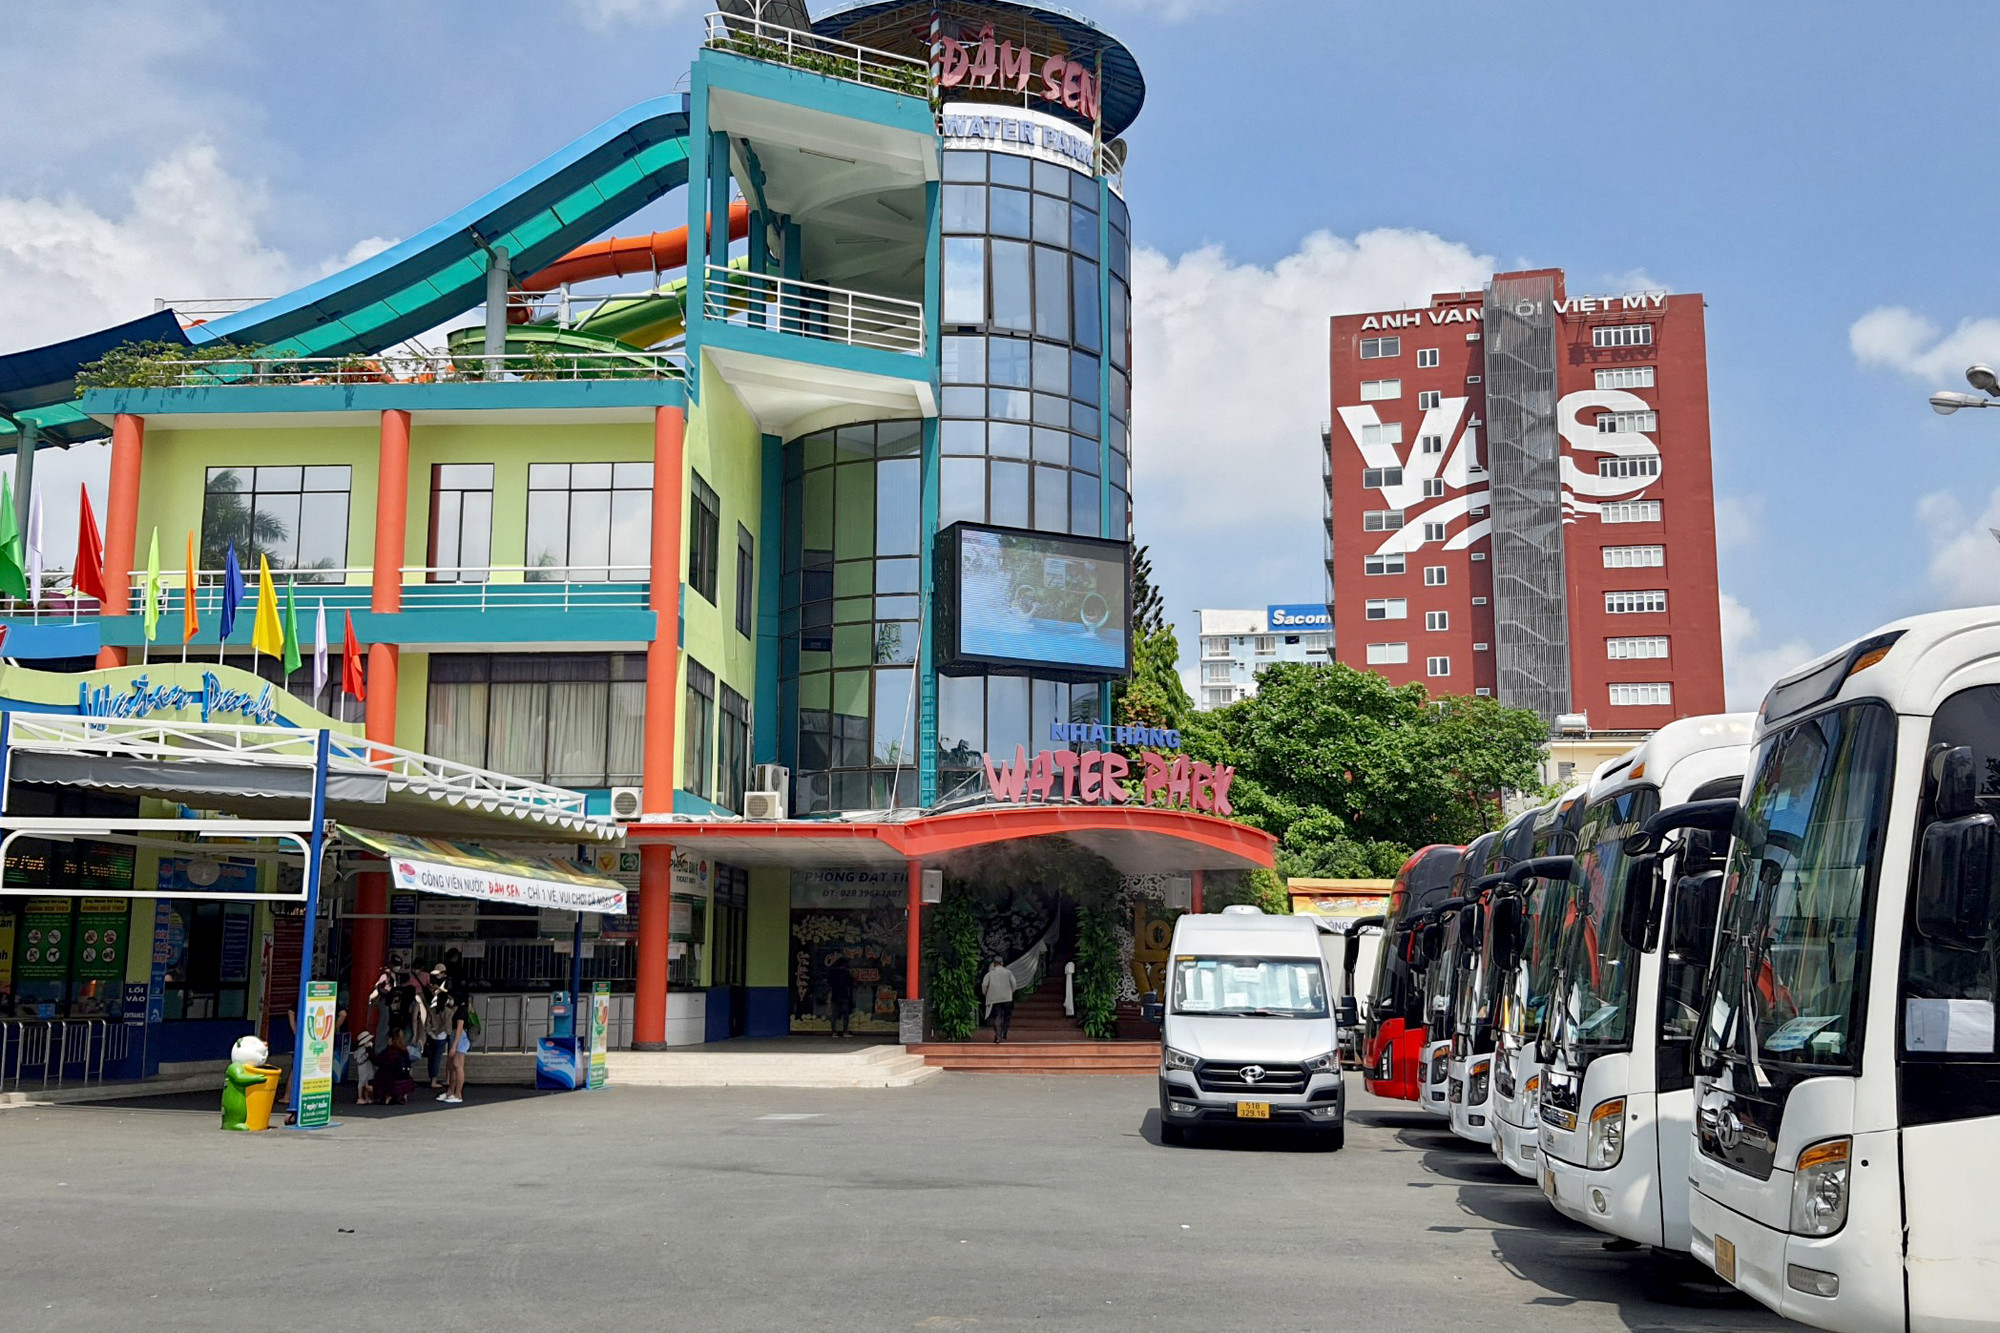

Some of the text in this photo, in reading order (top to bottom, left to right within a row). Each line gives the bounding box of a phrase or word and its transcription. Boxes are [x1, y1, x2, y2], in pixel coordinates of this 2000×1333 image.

[1041, 54, 1099, 121] SEN
[943, 114, 1035, 145] WATER
[1361, 316, 1421, 331] ANH
[1427, 305, 1484, 326] VĂN
[1553, 294, 1615, 316] VIỆT
[79, 670, 278, 732] Water Park
[1050, 719, 1182, 749] NHÀ HÀNG
[983, 743, 1236, 816] WATER PARK
[421, 870, 445, 889] CÔNG
[446, 873, 463, 891] VIÊN
[506, 884, 520, 898] SEN
[559, 891, 571, 905] VUI
[804, 868, 856, 883] PHÒNG
